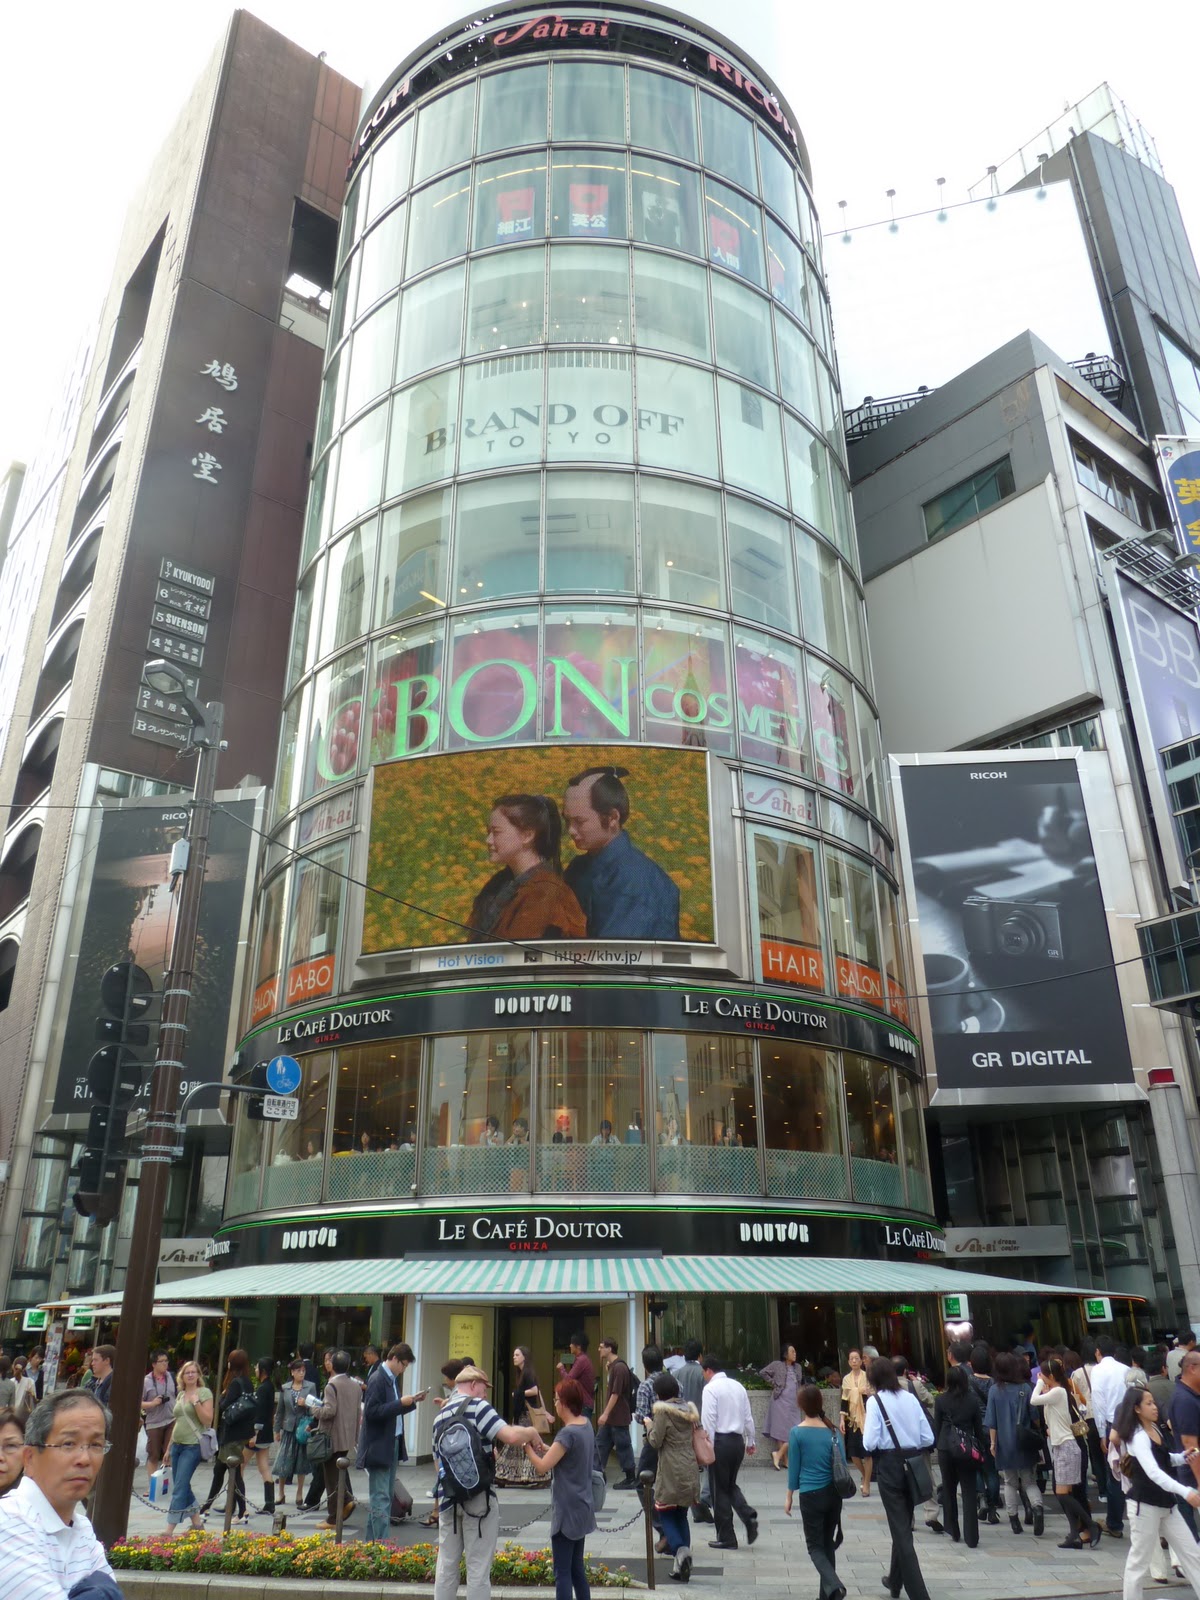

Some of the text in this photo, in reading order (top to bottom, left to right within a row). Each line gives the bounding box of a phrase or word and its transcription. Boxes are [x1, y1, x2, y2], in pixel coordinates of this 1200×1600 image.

[493, 15, 611, 46] San-ai
[708, 53, 798, 146] RICOH
[191, 359, 239, 484] 鳩居堂
[423, 403, 685, 456] BRAND OFF
[172, 567, 211, 590] KYUKYODO
[160, 588, 169, 599] 6
[155, 612, 164, 622] 5
[165, 613, 205, 635] SVENSON
[151, 637, 161, 648] 4
[142, 690, 151, 700] 2
[142, 700, 148, 708] 1
[136, 720, 147, 731] B
[645, 682, 848, 771] COSMETCS
[969, 771, 1008, 780] RICOH
[745, 787, 813, 821] San-ai
[437, 953, 504, 968] Hot Vision
[554, 950, 643, 965] http://khv.jp/
[289, 965, 331, 997] LA-BO
[768, 949, 819, 980] HAIR
[840, 966, 881, 997] SALON
[495, 994, 571, 1014] DOUTOR
[745, 1021, 776, 1031] GINZA
[314, 1033, 341, 1044] GINZA
[972, 1049, 1092, 1068] GR DIGITAL
[266, 1107, 296, 1117] ここまで
[282, 1227, 337, 1249] DOUTOR
[740, 1222, 809, 1243] DOUTOR
[510, 1242, 548, 1250] GINZA
